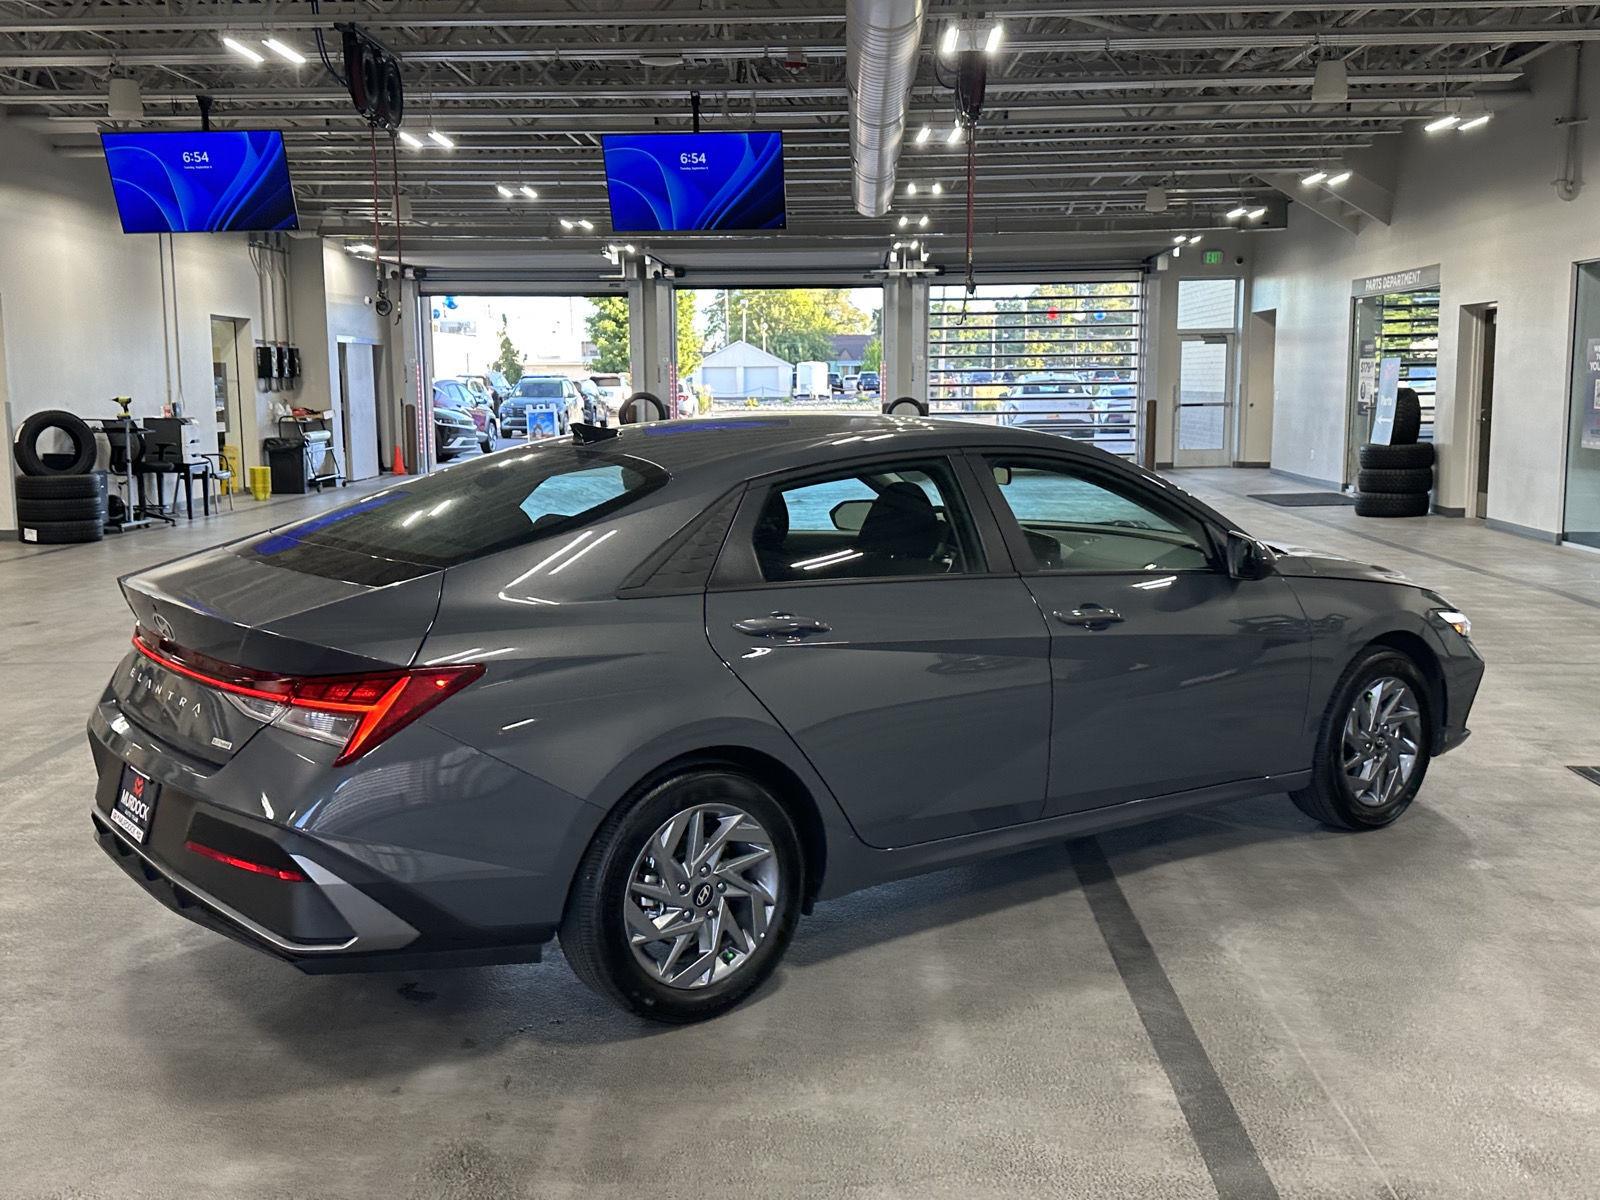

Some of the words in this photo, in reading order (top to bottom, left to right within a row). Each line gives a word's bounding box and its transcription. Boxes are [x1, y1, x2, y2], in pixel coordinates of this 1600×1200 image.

[183, 152, 209, 163] 6:54
[680, 153, 706, 164] 6:54
[1365, 278, 1382, 291] PARTS
[1382, 271, 1421, 289] DEPARTMENT
[130, 668, 201, 717] ELANTRA
[121, 789, 149, 821] MURDOCK
